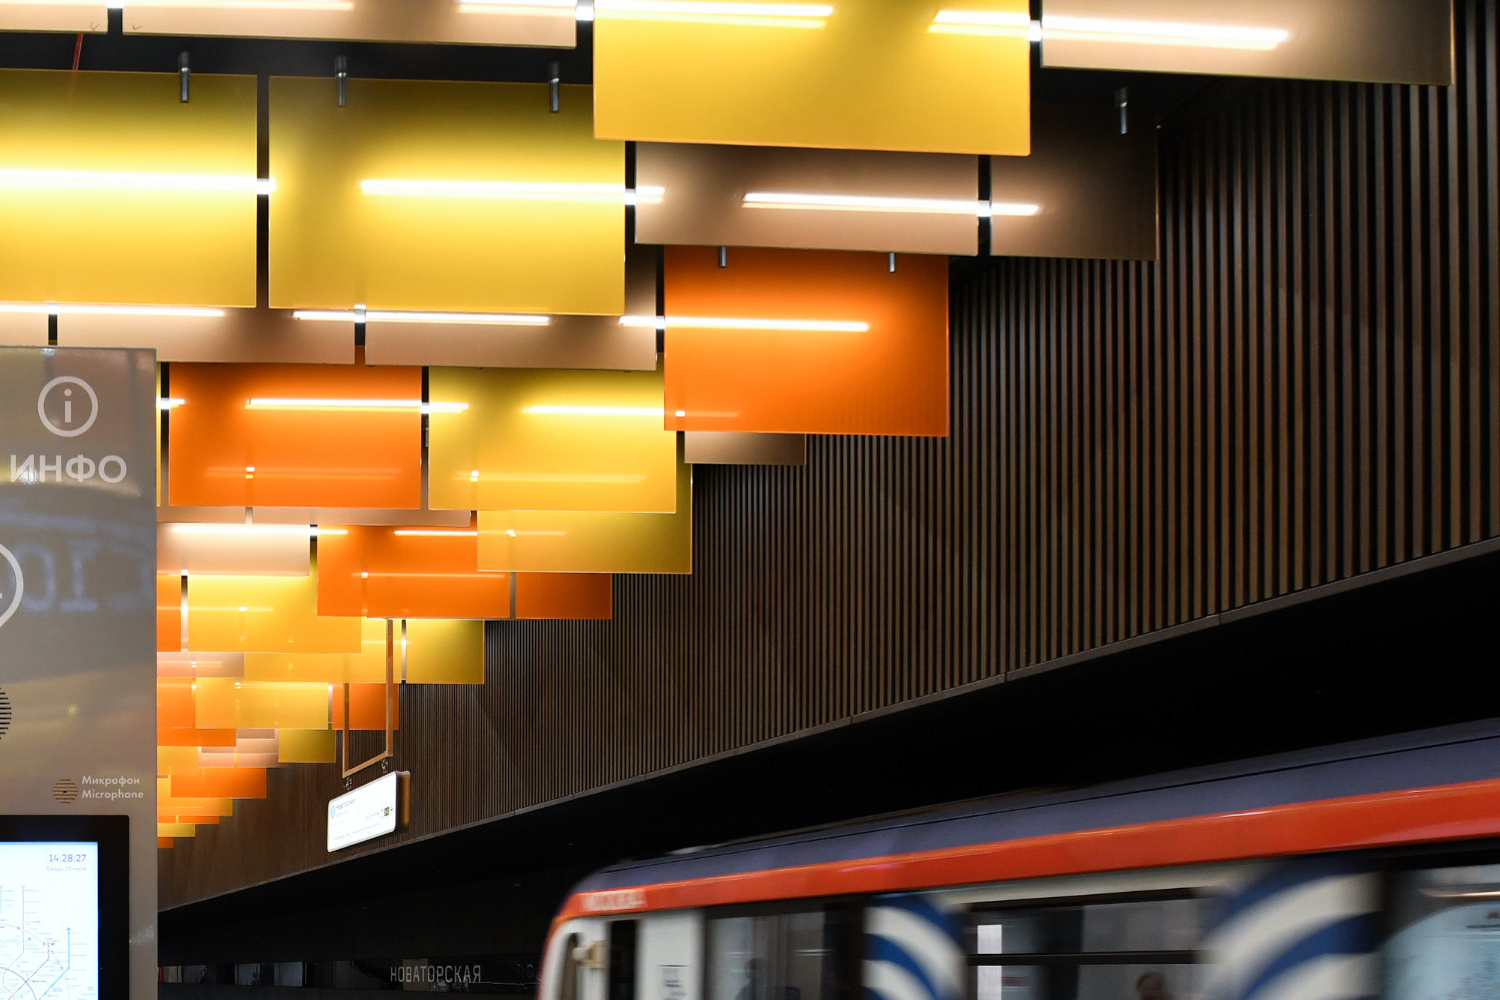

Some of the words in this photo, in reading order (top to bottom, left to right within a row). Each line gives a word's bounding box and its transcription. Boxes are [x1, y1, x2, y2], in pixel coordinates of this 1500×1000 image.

[10, 454, 127, 484] ИНФО
[82, 775, 140, 788] Микрофон
[82, 788, 144, 801] Microphone
[49, 854, 87, 863] 14:28:27
[390, 964, 482, 984] НОВАТОРСКАЯ
